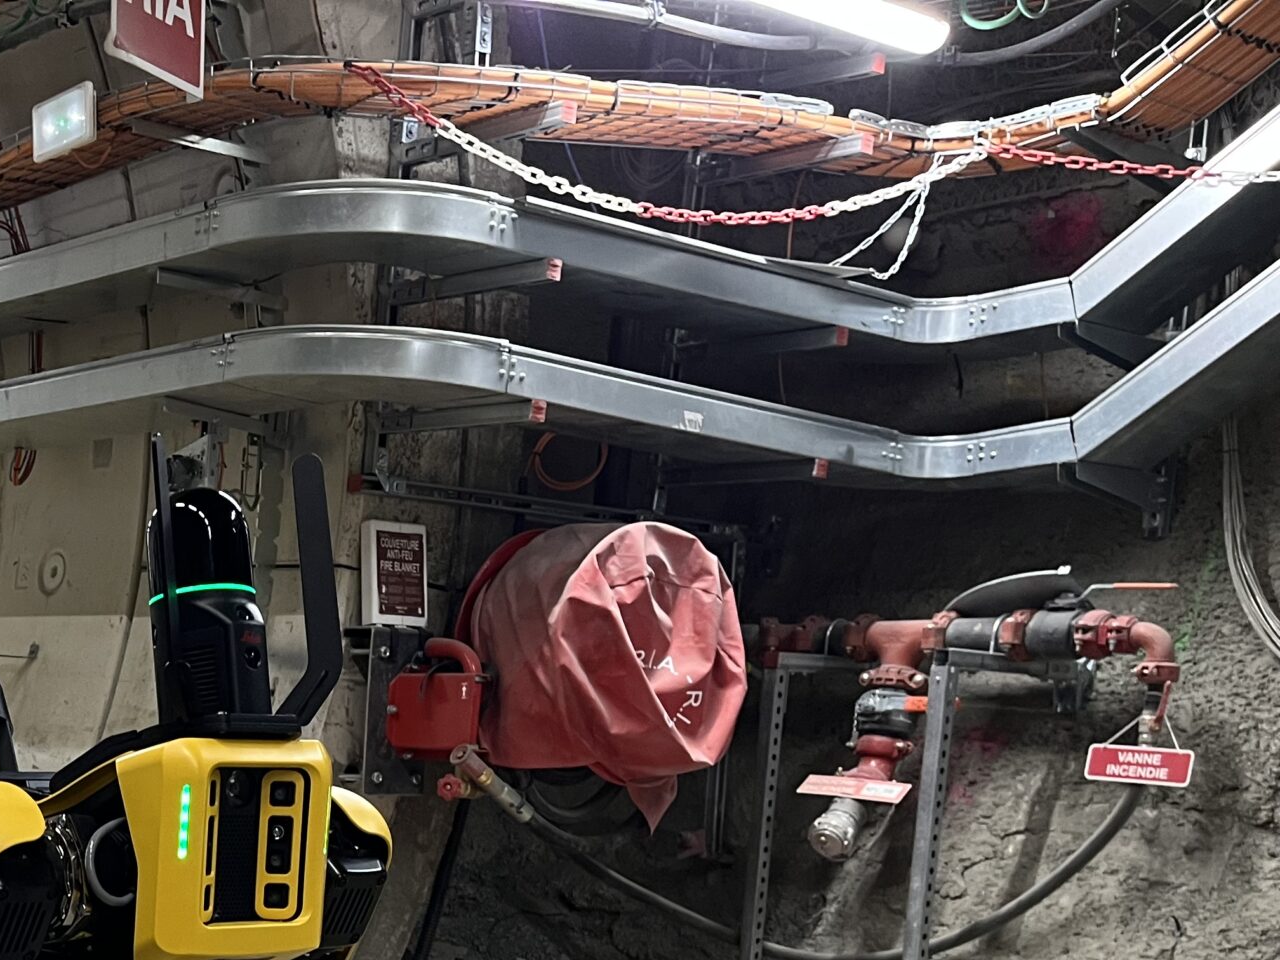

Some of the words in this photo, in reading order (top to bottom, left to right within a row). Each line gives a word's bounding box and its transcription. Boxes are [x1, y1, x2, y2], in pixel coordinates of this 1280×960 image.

[380, 537, 420, 551] COUVERTURE
[387, 549, 414, 561] ANTI-FEU
[380, 560, 393, 572] FIRE
[394, 561, 421, 573] BLANKET
[1117, 751, 1162, 766] VANNE
[1105, 763, 1169, 780] INCENDIE
